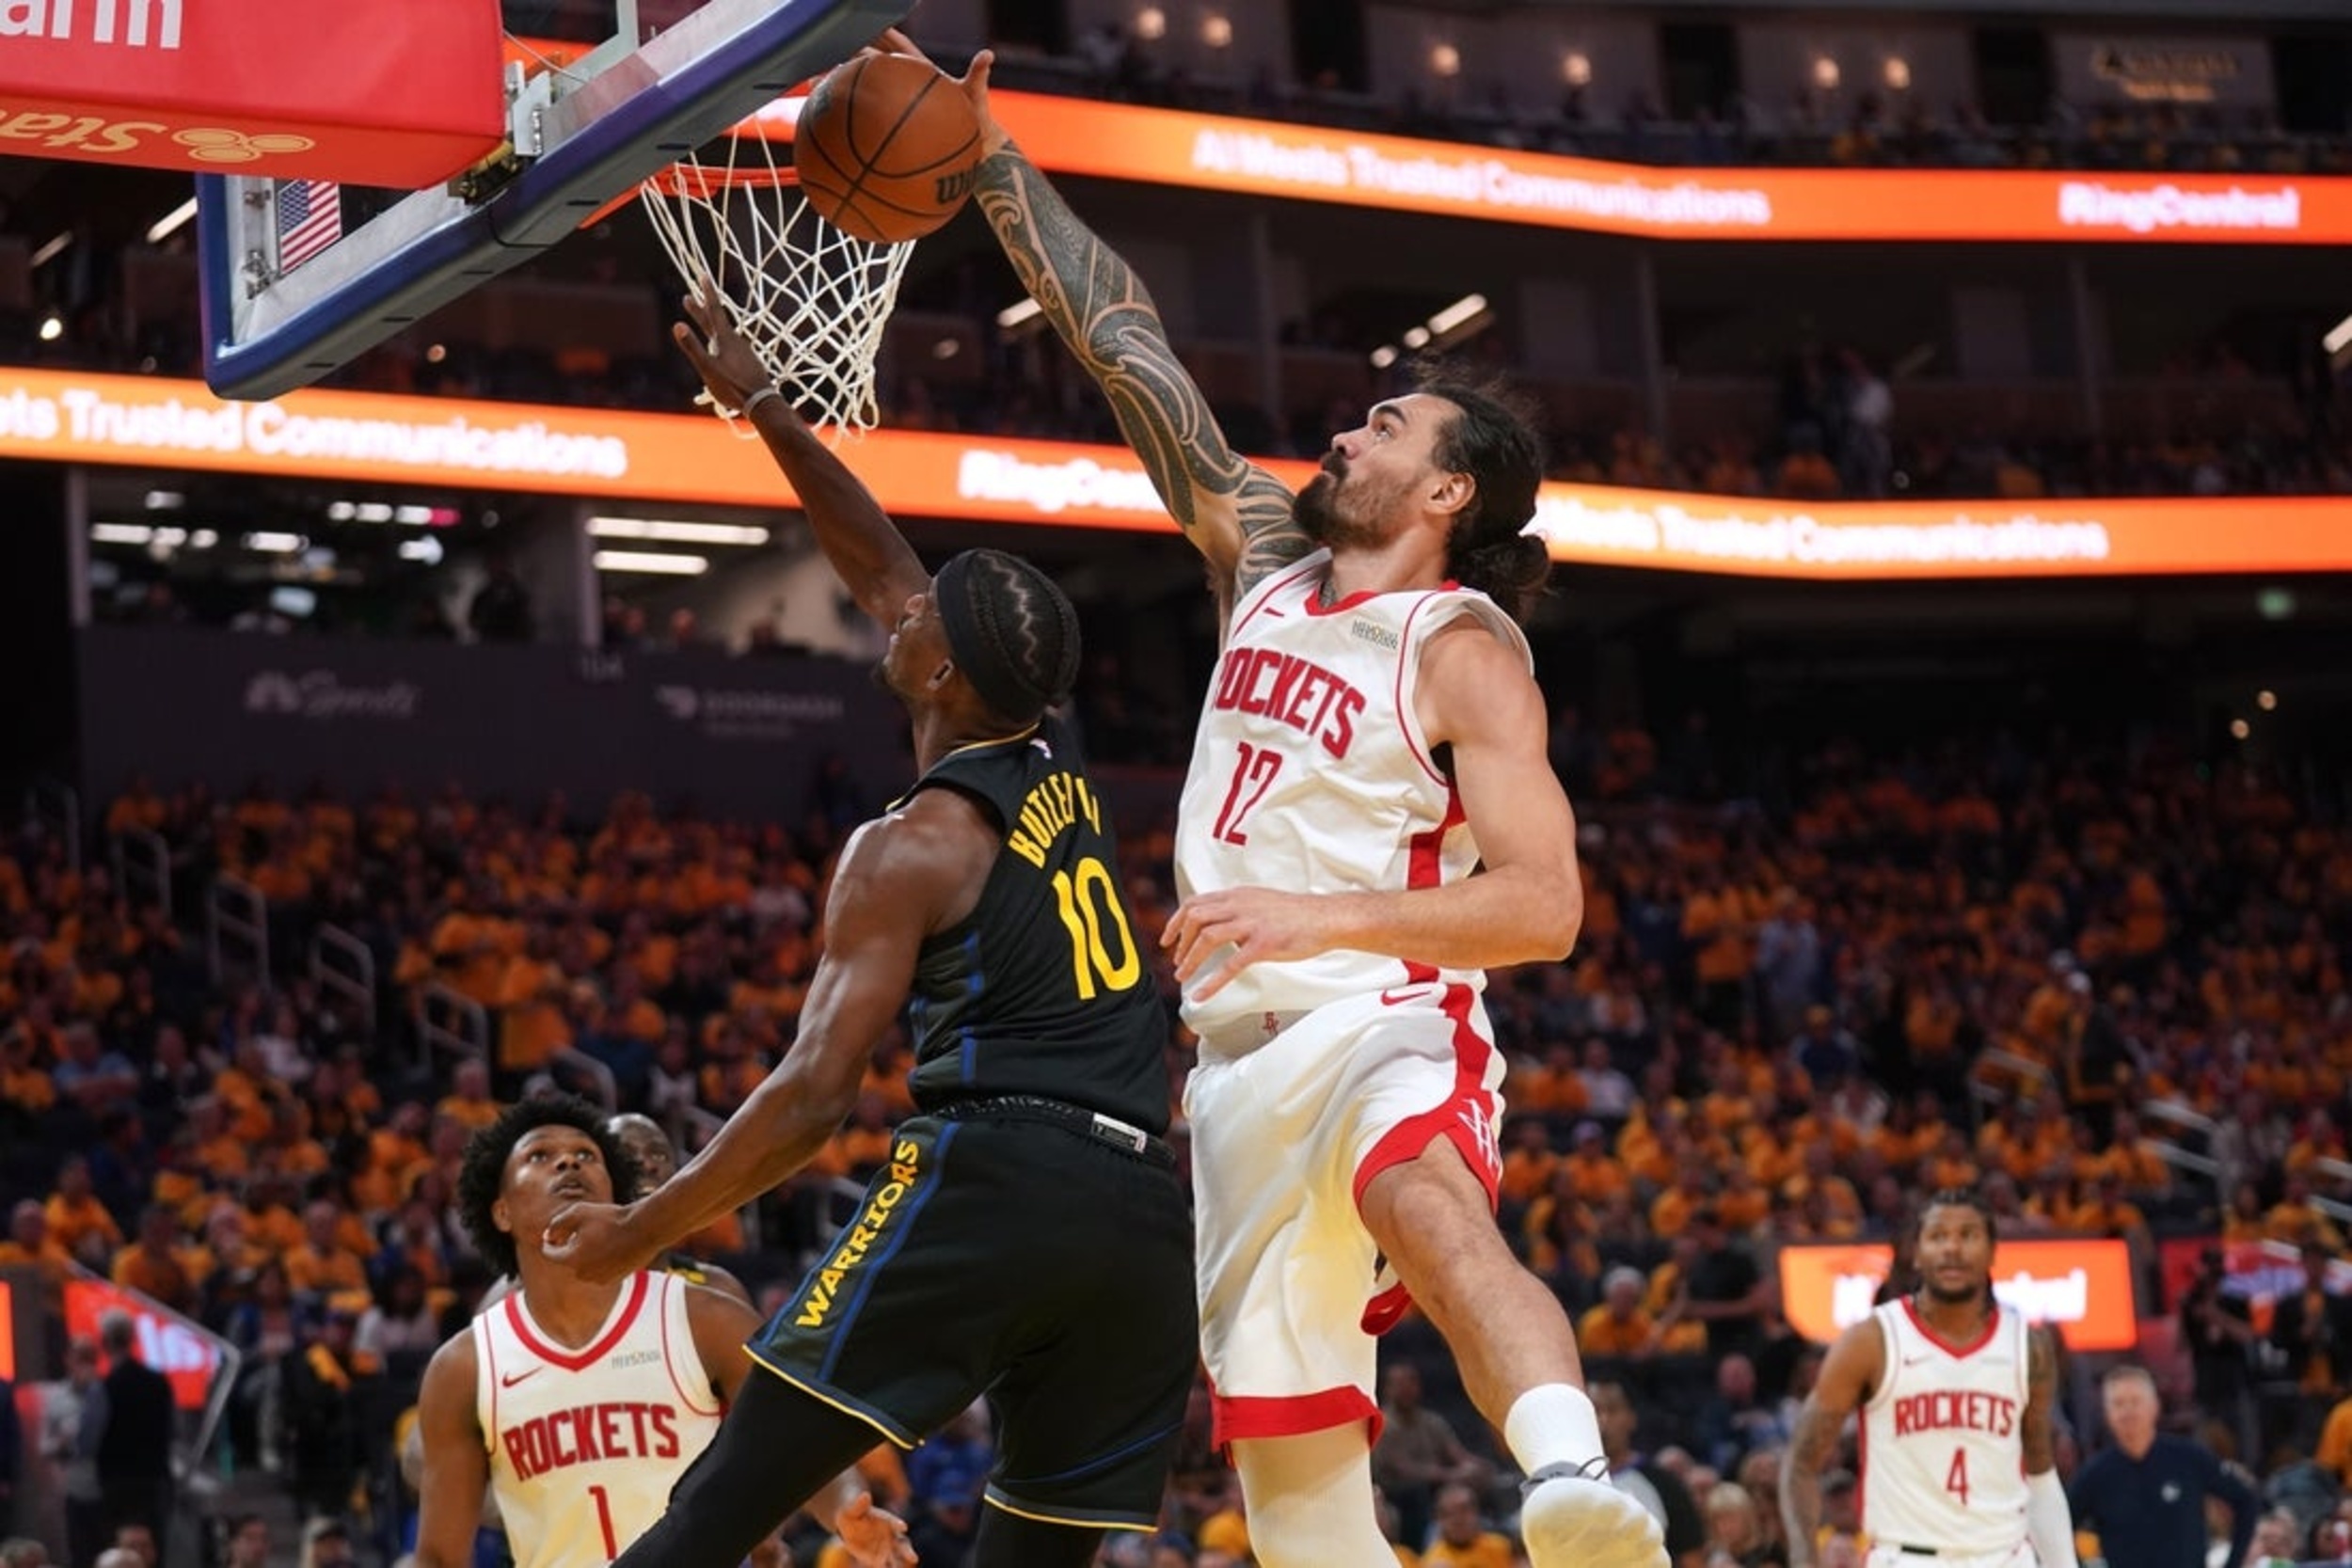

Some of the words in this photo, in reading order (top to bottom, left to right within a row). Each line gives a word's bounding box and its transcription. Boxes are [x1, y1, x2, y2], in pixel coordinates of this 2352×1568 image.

[0, 108, 167, 152] Sta
[1348, 144, 1481, 201] Trusted
[1483, 158, 1772, 225] Communications
[2058, 182, 2300, 233] RingCentral
[61, 388, 243, 451] Trusted
[245, 399, 628, 478] Communications
[1789, 513, 2109, 562] Communications
[1212, 645, 1367, 760] OCKETS
[1212, 740, 1283, 847] 12
[1050, 857, 1140, 1000] 10
[795, 1139, 920, 1327] WARRIORS
[501, 1402, 680, 1482] ROCKETS
[1894, 1389, 2016, 1437] ROCKETS
[1947, 1445, 1969, 1506] 4
[587, 1484, 618, 1561] 1
